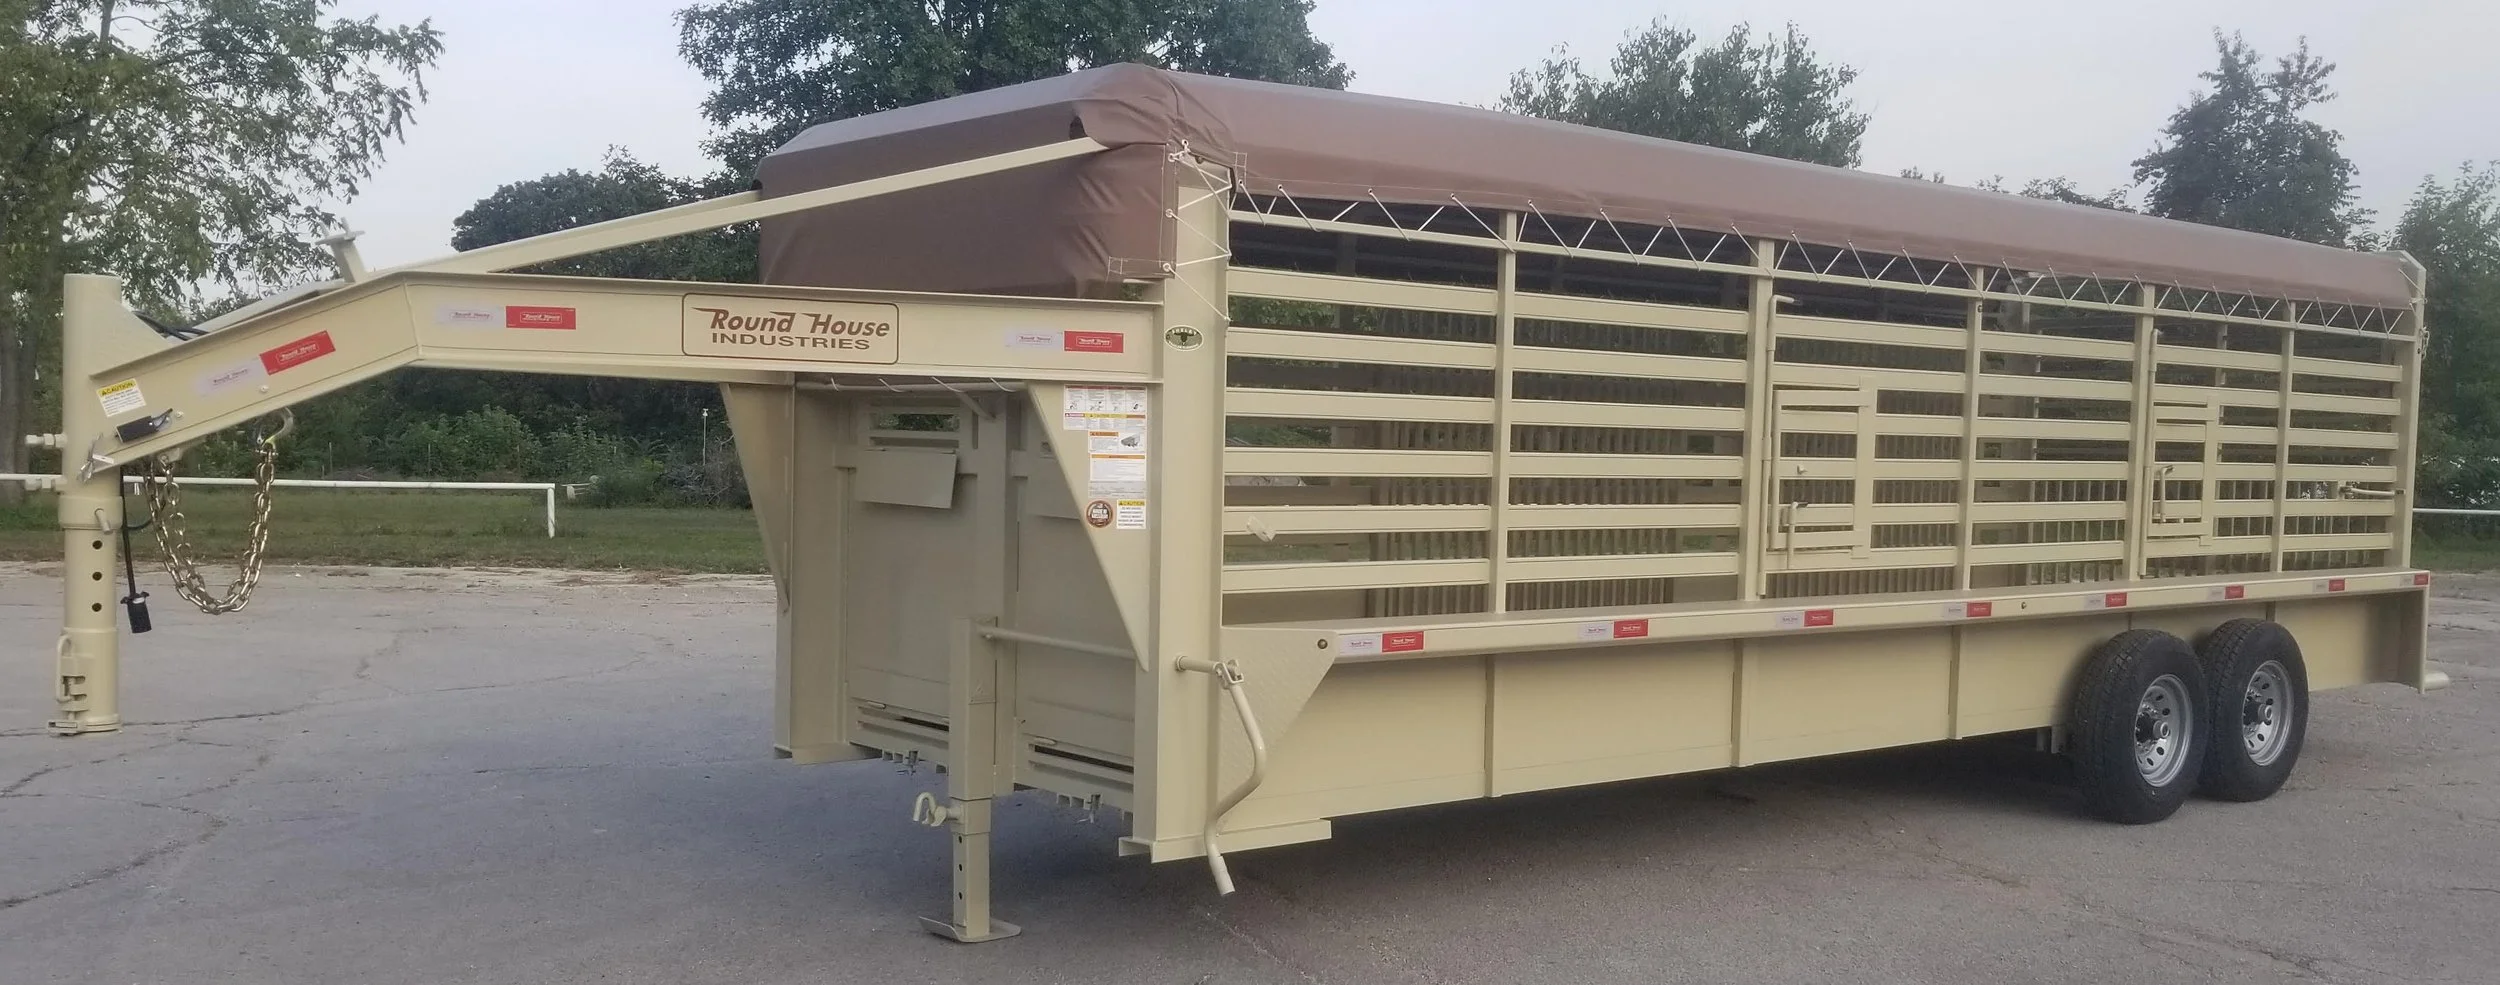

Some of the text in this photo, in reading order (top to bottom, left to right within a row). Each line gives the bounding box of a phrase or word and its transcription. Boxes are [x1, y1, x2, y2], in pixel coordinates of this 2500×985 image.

[691, 306, 890, 337] Round House
[712, 332, 870, 350] INDUSTRIES
[106, 381, 134, 394] CAUTION
